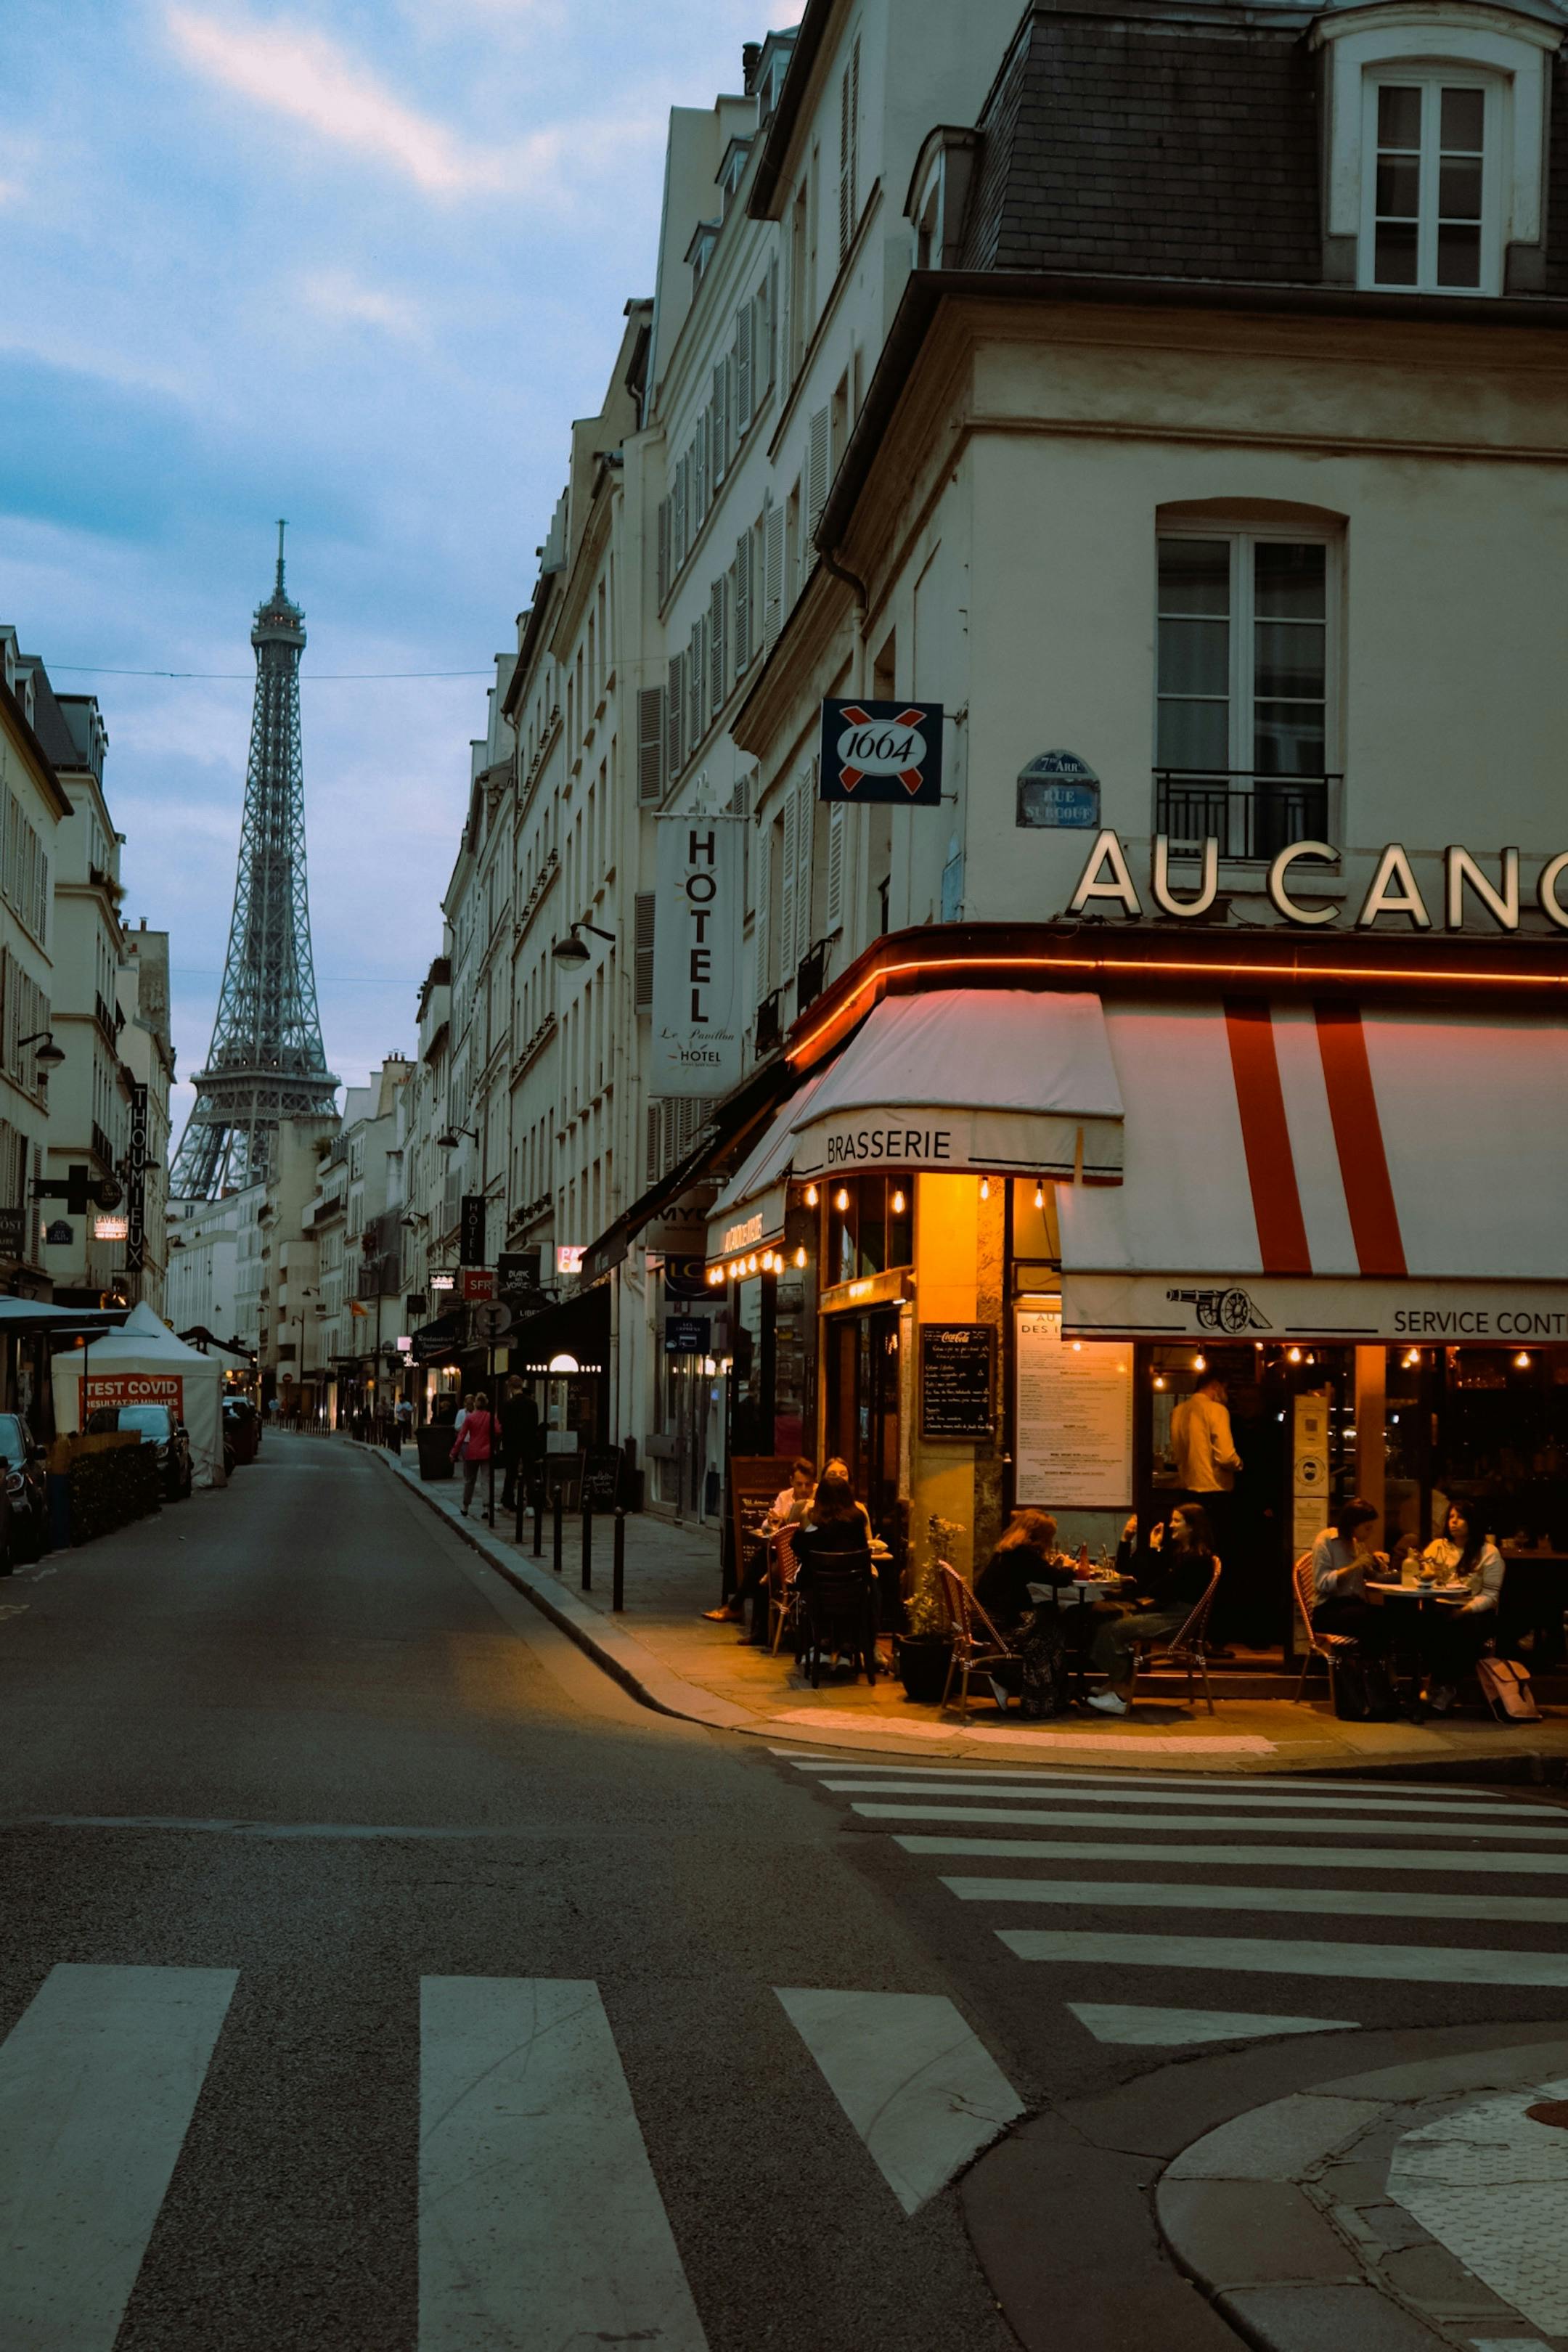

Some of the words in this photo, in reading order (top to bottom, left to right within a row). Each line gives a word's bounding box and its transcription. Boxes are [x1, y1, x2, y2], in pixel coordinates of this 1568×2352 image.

[846, 728, 917, 763] 1664
[1044, 789, 1075, 802] RUE
[1064, 828, 1219, 920] AU
[685, 830, 716, 1023] HOTEL
[689, 1029, 735, 1040] Pavillon
[681, 1050, 721, 1061] HOTEL
[828, 1130, 951, 1163] BRASSERIE
[128, 1088, 145, 1267] THOUMIEUX
[95, 1215, 127, 1224] LAVERIE
[470, 1280, 492, 1290] SFR
[1037, 1313, 1055, 1322] AU
[1395, 1311, 1489, 1333] SERVICE
[1497, 1312, 1568, 1334] CONT
[86, 1381, 124, 1396] TEST
[128, 1381, 179, 1395] COVID
